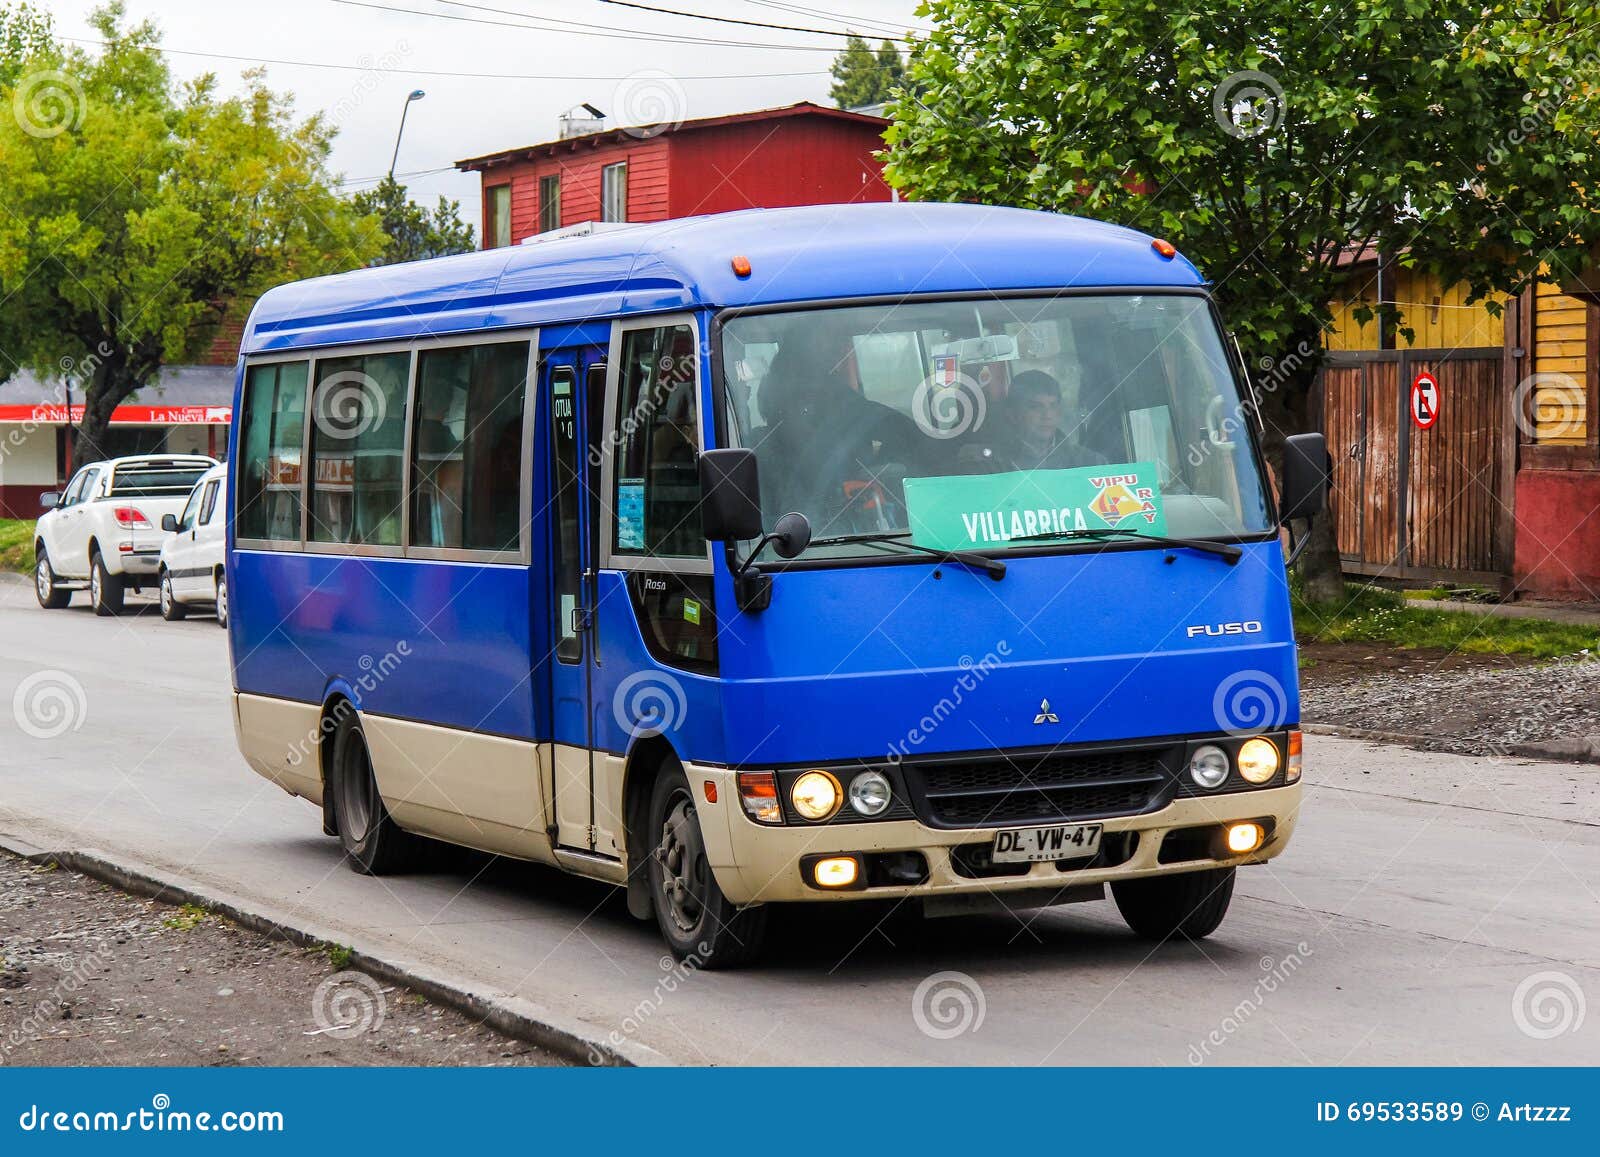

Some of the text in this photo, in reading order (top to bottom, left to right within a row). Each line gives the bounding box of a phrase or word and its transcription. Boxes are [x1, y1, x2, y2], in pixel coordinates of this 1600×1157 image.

[150, 410, 165, 422] La
[168, 410, 204, 422] Nueva
[1088, 474, 1138, 489] VIPU
[1137, 488, 1156, 525] RAY
[961, 507, 1089, 543] VILLARRICA
[1186, 620, 1262, 638] FUSO
[1028, 852, 1065, 860] CHILE
